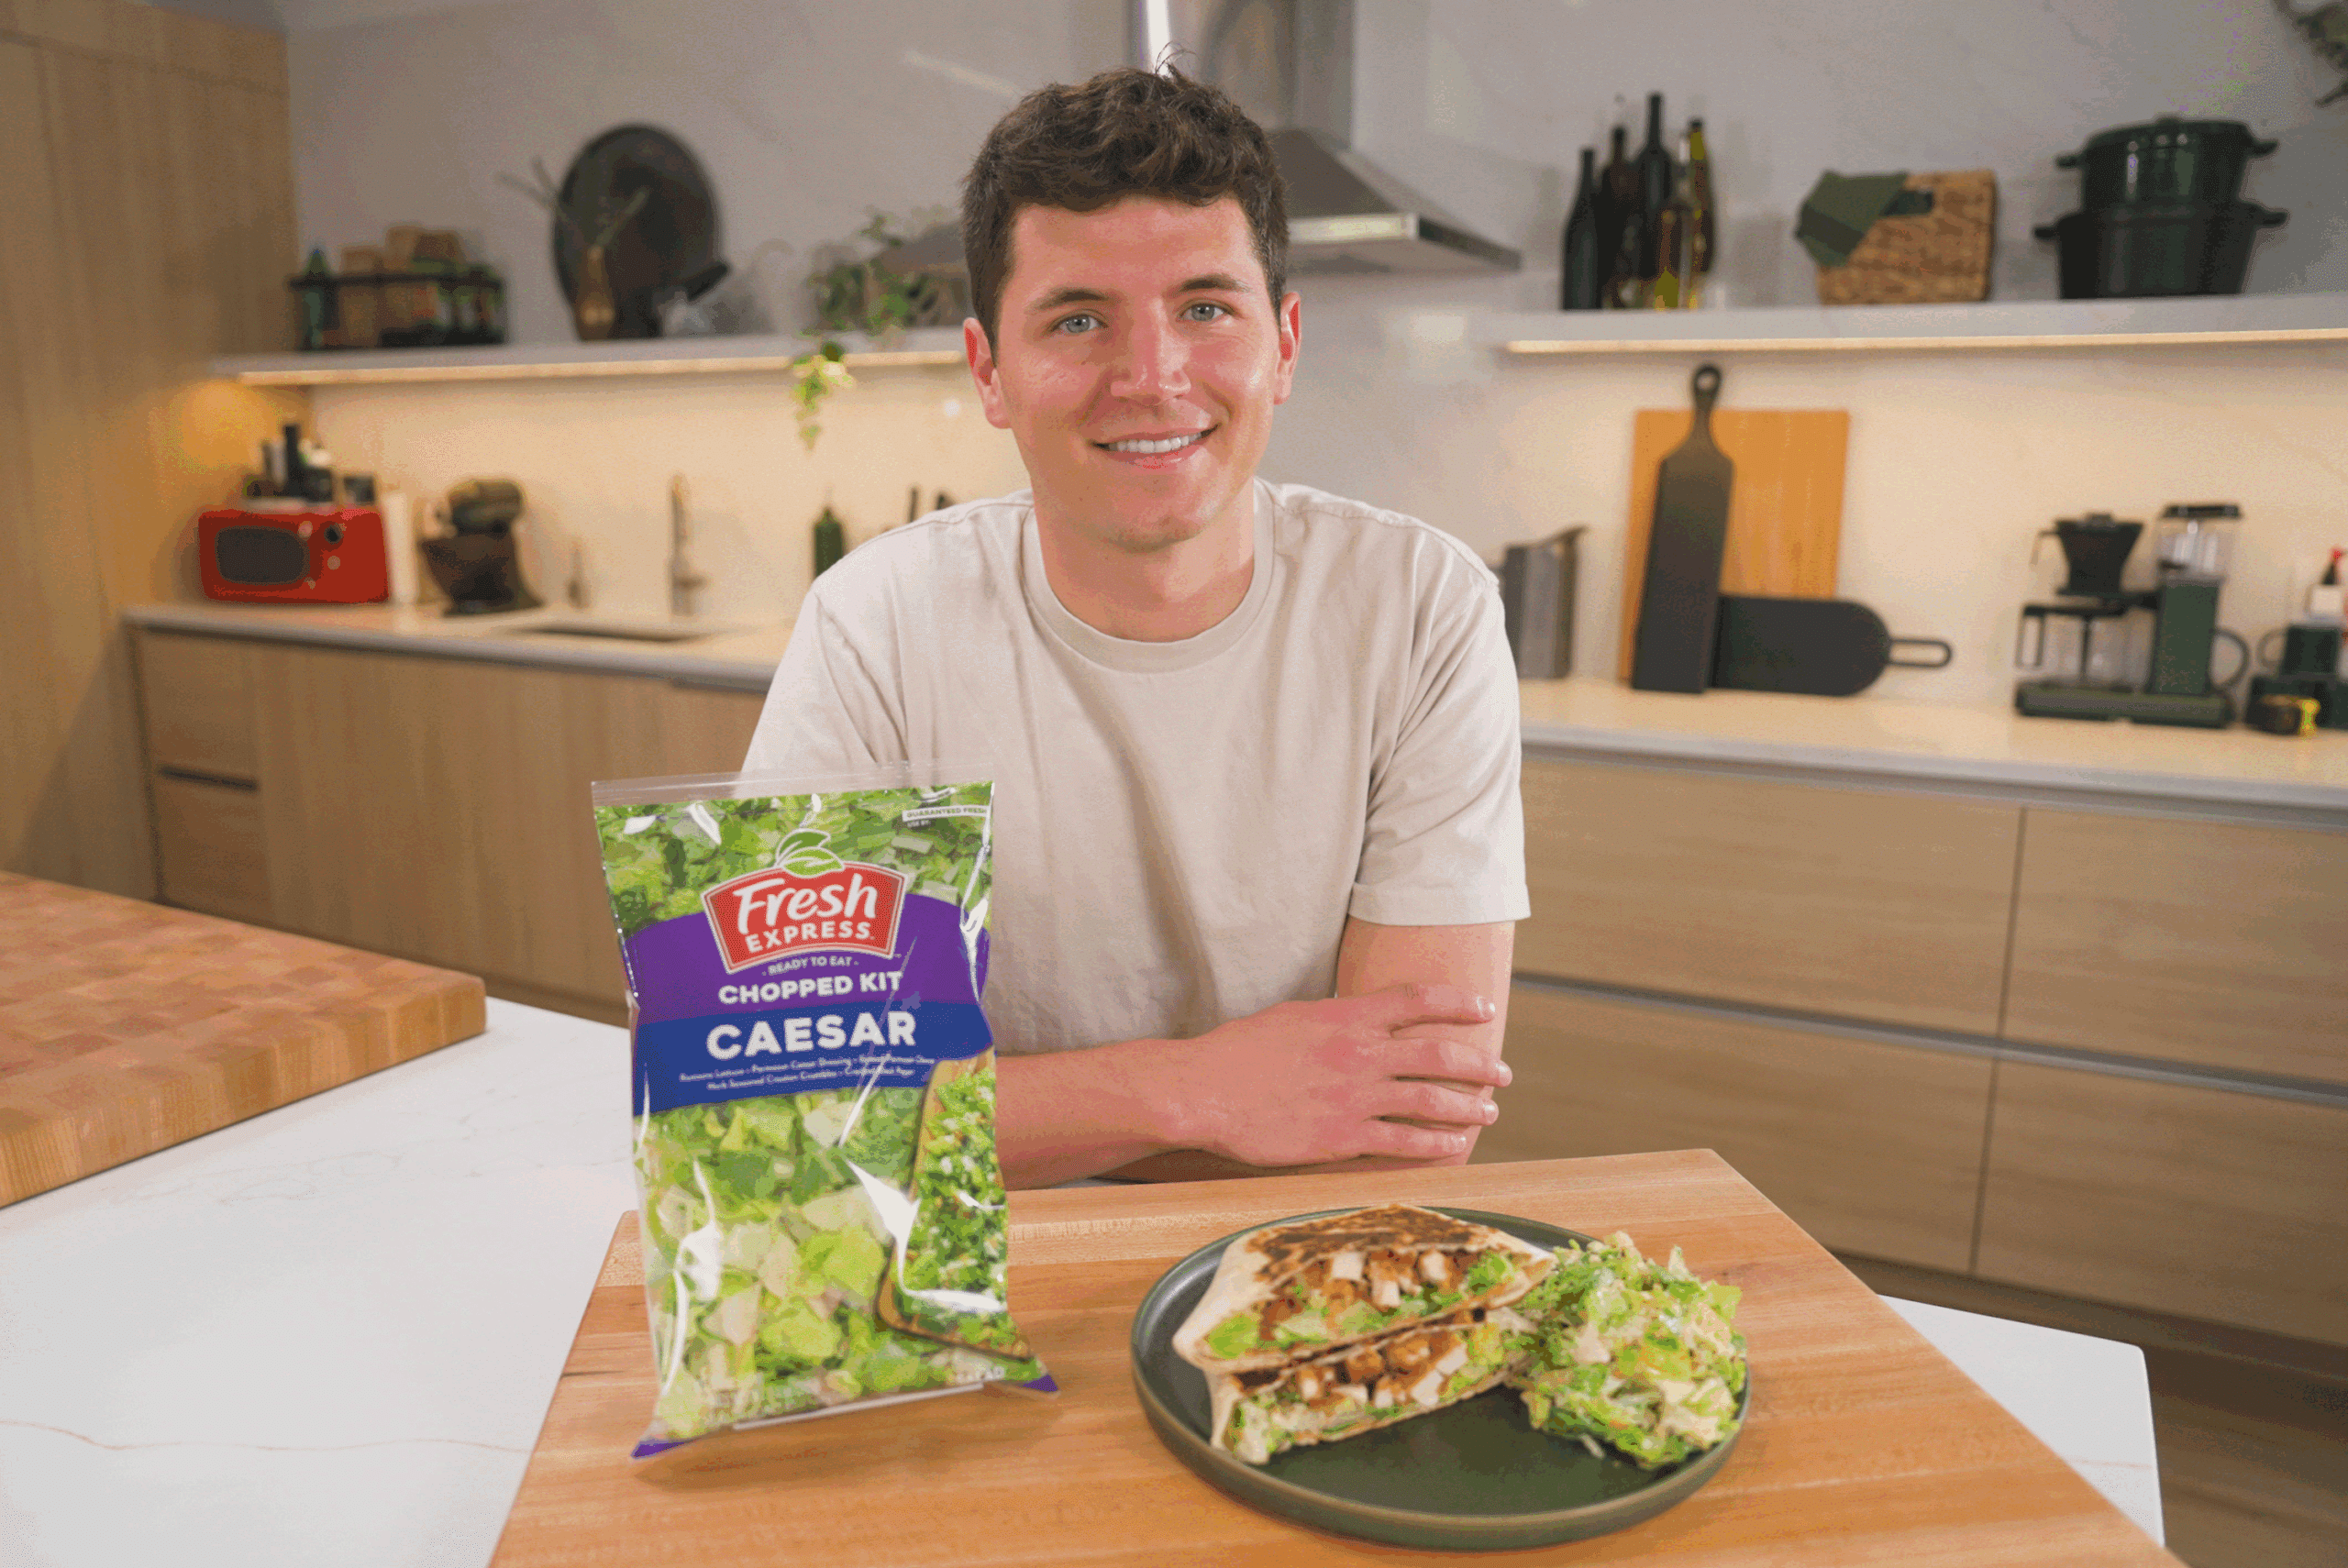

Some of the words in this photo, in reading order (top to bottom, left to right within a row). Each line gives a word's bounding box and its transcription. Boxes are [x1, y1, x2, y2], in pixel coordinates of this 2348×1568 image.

[906, 807, 961, 818] GUARANTEED
[732, 873, 878, 934] Fresh
[745, 921, 871, 953] EXPRESS
[768, 957, 808, 976] READY
[811, 955, 827, 966] TO
[829, 955, 853, 966] EAT
[718, 975, 854, 1005] CHOPPED
[859, 970, 903, 992] KIT
[706, 1010, 916, 1060] CAESAR
